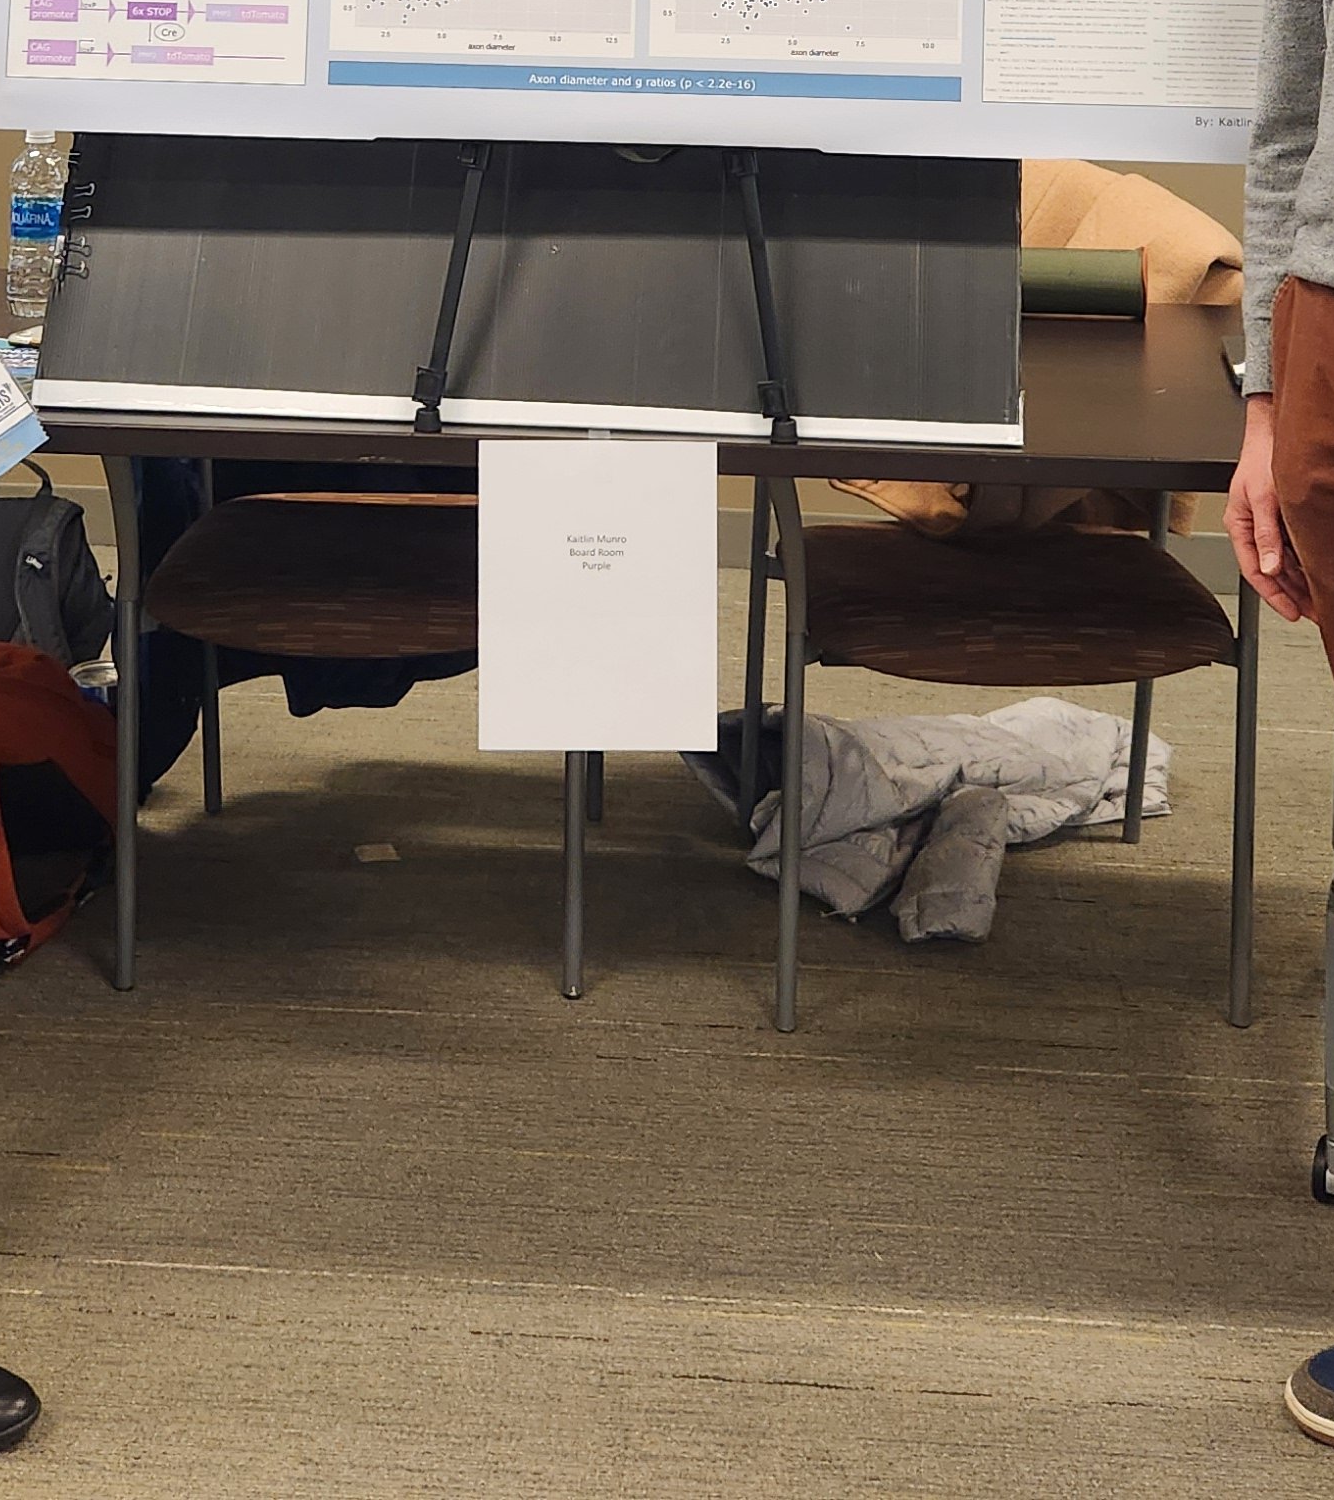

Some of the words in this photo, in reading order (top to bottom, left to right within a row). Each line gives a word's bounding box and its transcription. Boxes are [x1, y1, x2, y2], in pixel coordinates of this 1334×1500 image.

[132, 7, 144, 16] 6x
[147, 7, 172, 17] STOP
[161, 28, 177, 37] Cre
[528, 74, 556, 83] Axon
[559, 74, 608, 85] diameter
[611, 75, 631, 86] and
[635, 78, 642, 88] g
[645, 76, 676, 87] ratios
[680, 77, 692, 89] (p
[707, 78, 755, 91] 2.2e-16)
[1195, 116, 1213, 127] By:
[567, 535, 594, 543] Kaitlin
[597, 535, 627, 543] Munro
[569, 548, 596, 557] Board
[598, 548, 624, 557] Room
[582, 561, 611, 571] Purple
